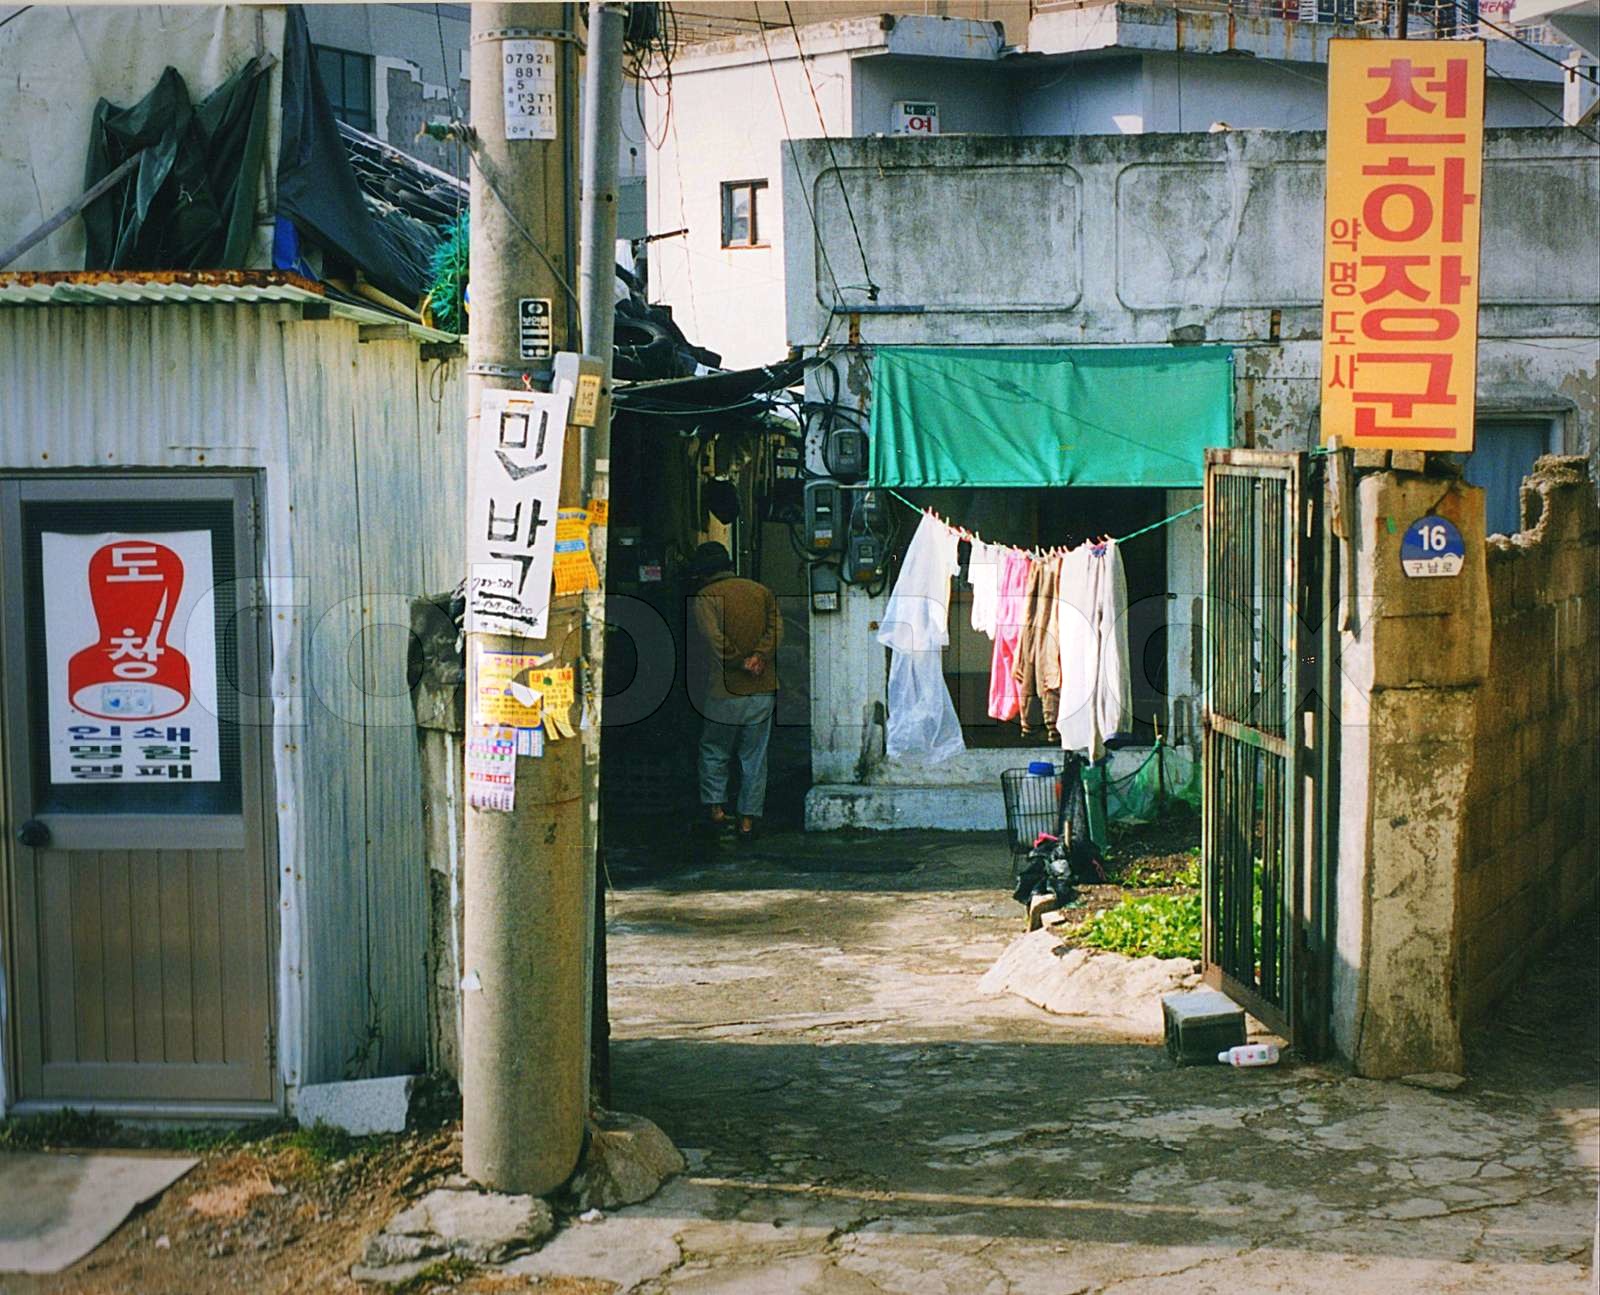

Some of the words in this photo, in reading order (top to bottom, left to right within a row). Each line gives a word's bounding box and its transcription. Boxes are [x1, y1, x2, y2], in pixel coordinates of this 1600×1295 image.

[515, 67, 542, 79] 881
[517, 80, 525, 91] 5
[1352, 58, 1477, 439] 천하장군
[1328, 216, 1363, 390] 약명도사
[487, 409, 549, 596] 민박
[1417, 525, 1447, 551] 16
[67, 725, 191, 743] 인쇄
[69, 745, 199, 761] 명함
[70, 764, 193, 780] 명패
